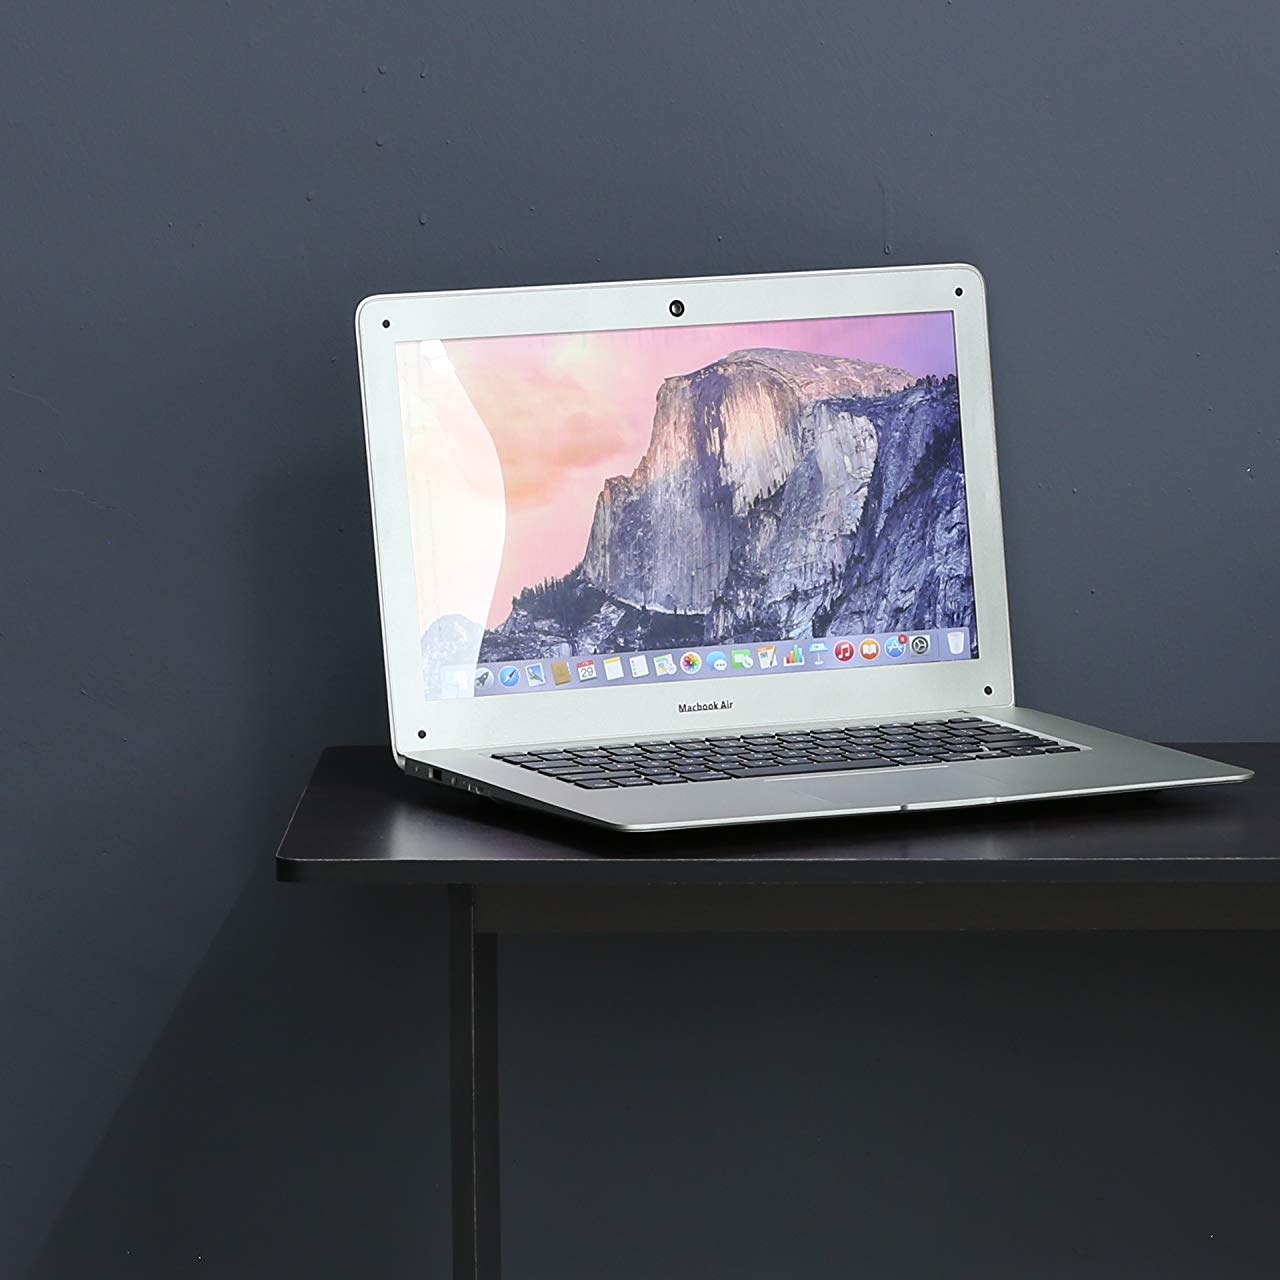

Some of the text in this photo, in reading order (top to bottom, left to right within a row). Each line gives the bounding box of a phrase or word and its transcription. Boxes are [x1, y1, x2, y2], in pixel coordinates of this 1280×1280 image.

[580, 666, 594, 677] 29
[678, 700, 733, 713] Macbook Air
